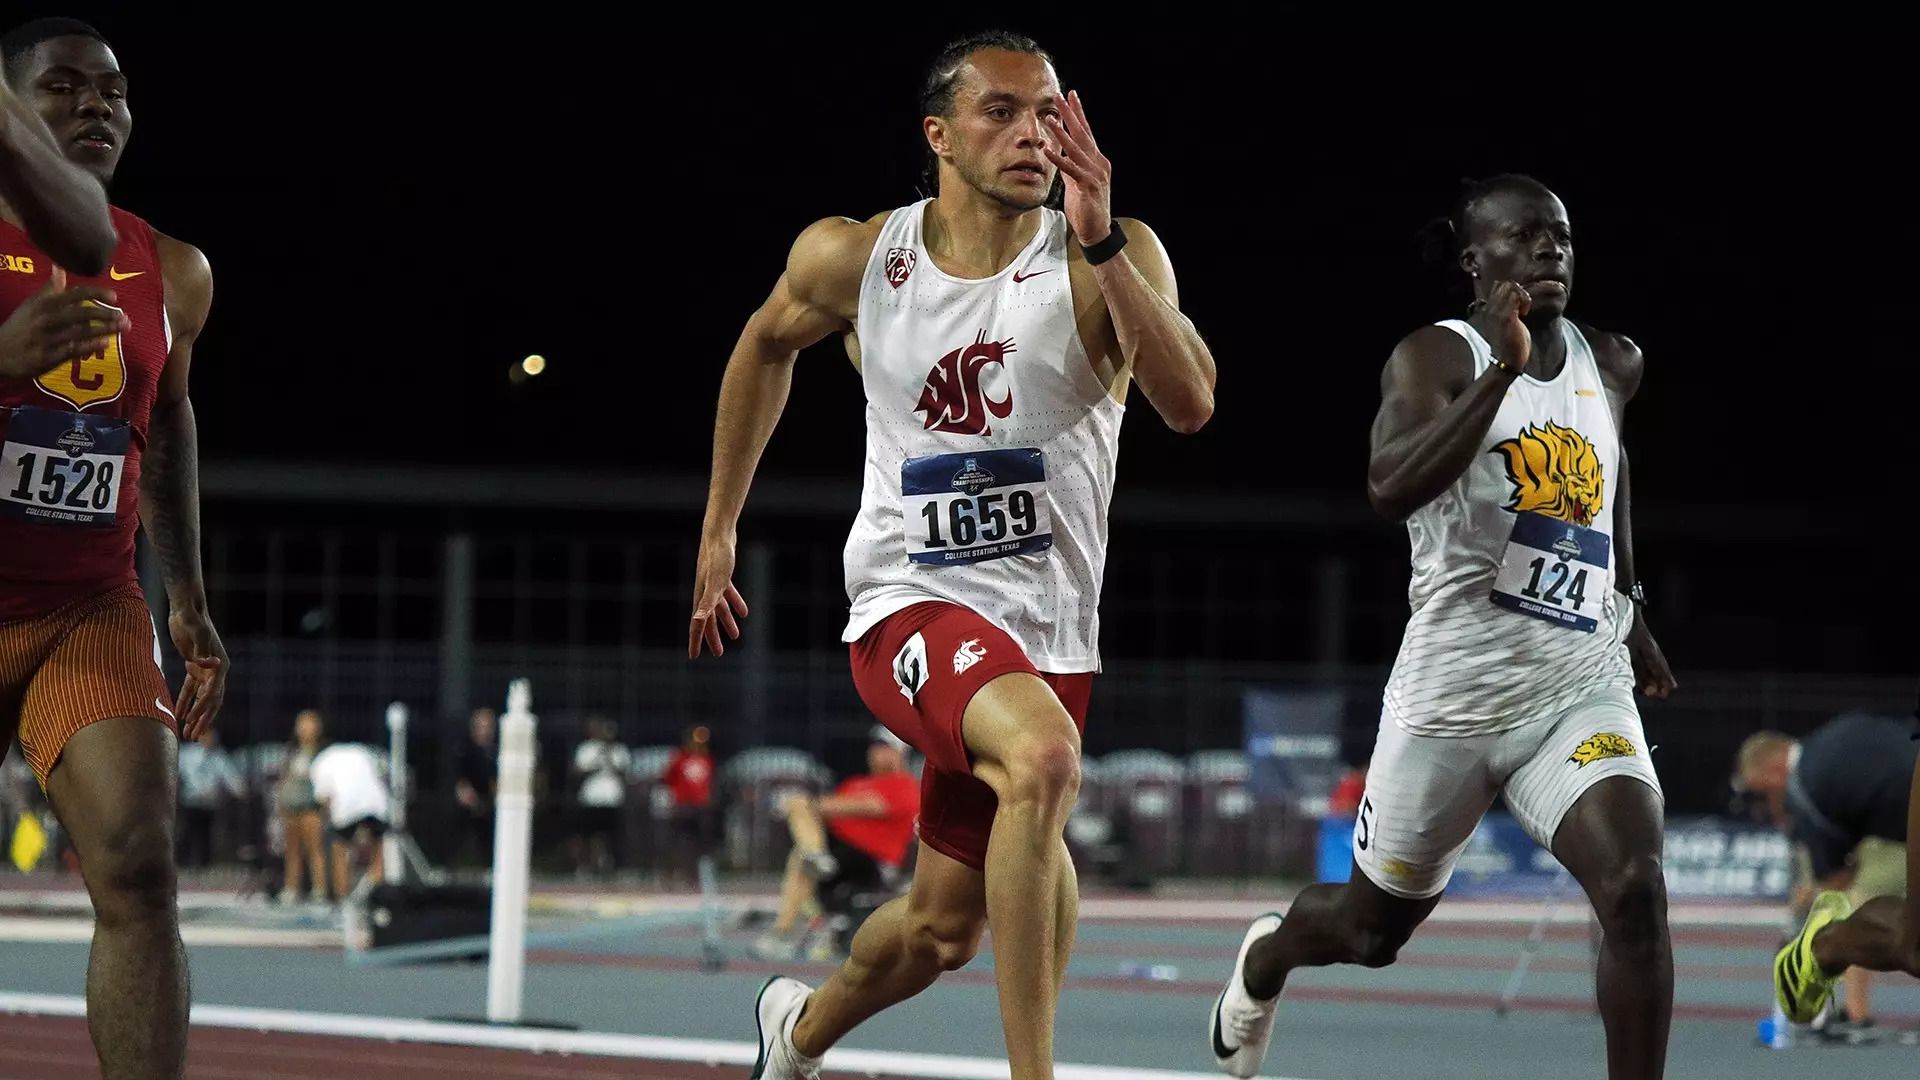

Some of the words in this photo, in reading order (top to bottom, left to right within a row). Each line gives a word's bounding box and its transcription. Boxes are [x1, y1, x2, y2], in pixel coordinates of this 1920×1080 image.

[886, 249, 916, 275] PAC
[890, 266, 906, 282] 12
[10, 452, 114, 510] 1528
[953, 476, 994, 486] CHAMPIONSHIPS
[25, 507, 51, 518] COLLEGE
[77, 514, 94, 522] TEXAS
[921, 490, 1037, 548] 1659
[944, 550, 971, 560] COLLEGE
[972, 546, 1000, 557] STATION,
[1001, 542, 1020, 552] TEXAS
[1521, 557, 1588, 611] 124
[1358, 796, 1373, 851] 5
